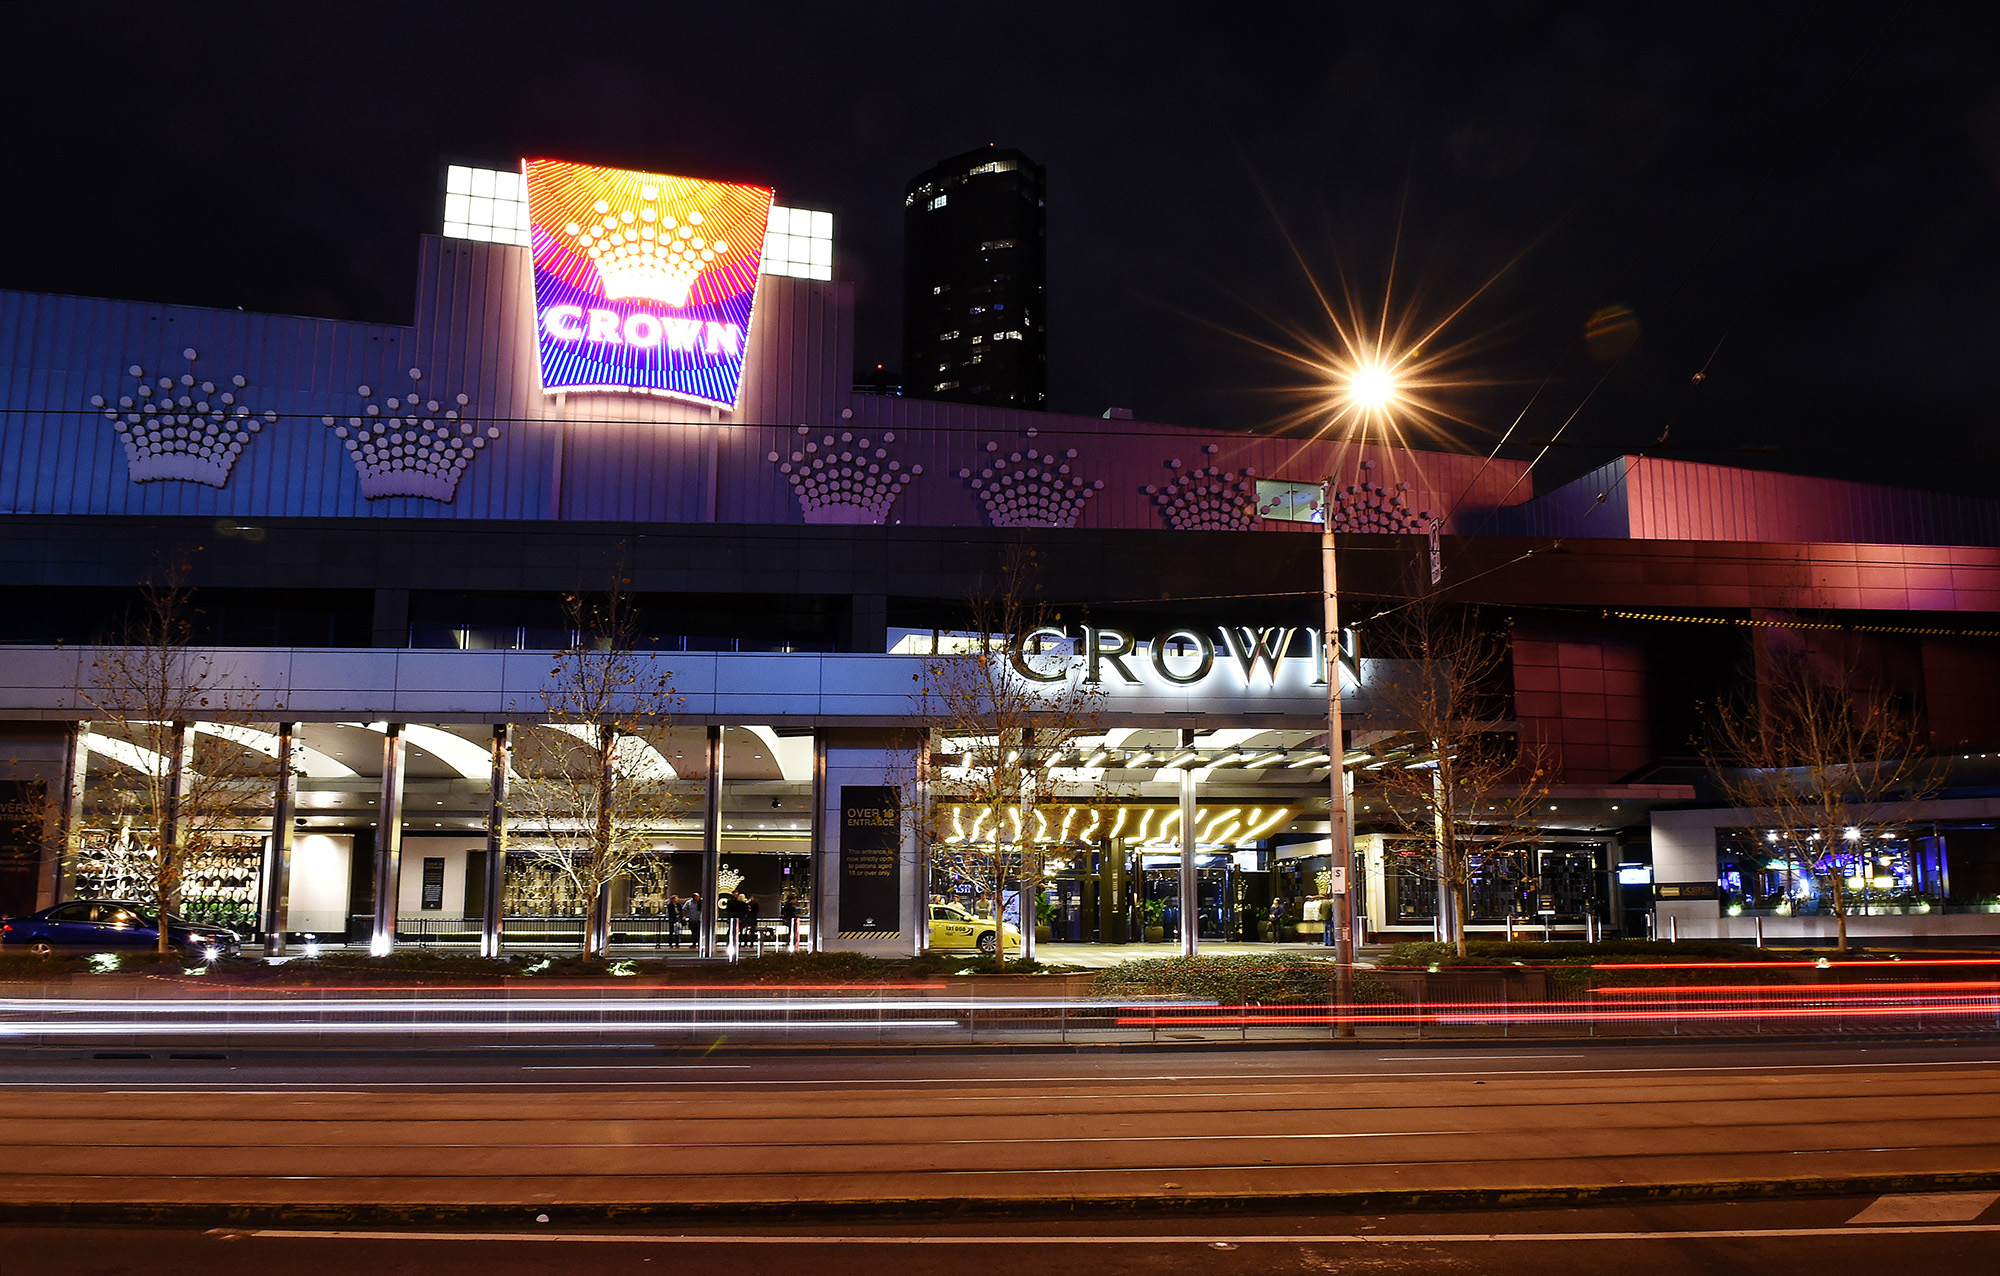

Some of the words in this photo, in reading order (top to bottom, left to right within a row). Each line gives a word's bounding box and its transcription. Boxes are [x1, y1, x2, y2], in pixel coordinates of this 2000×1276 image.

[545, 304, 740, 355] CROWN
[1009, 624, 1364, 688] CROWN
[847, 808, 880, 818] OVER
[847, 818, 895, 827] ENTRACE
